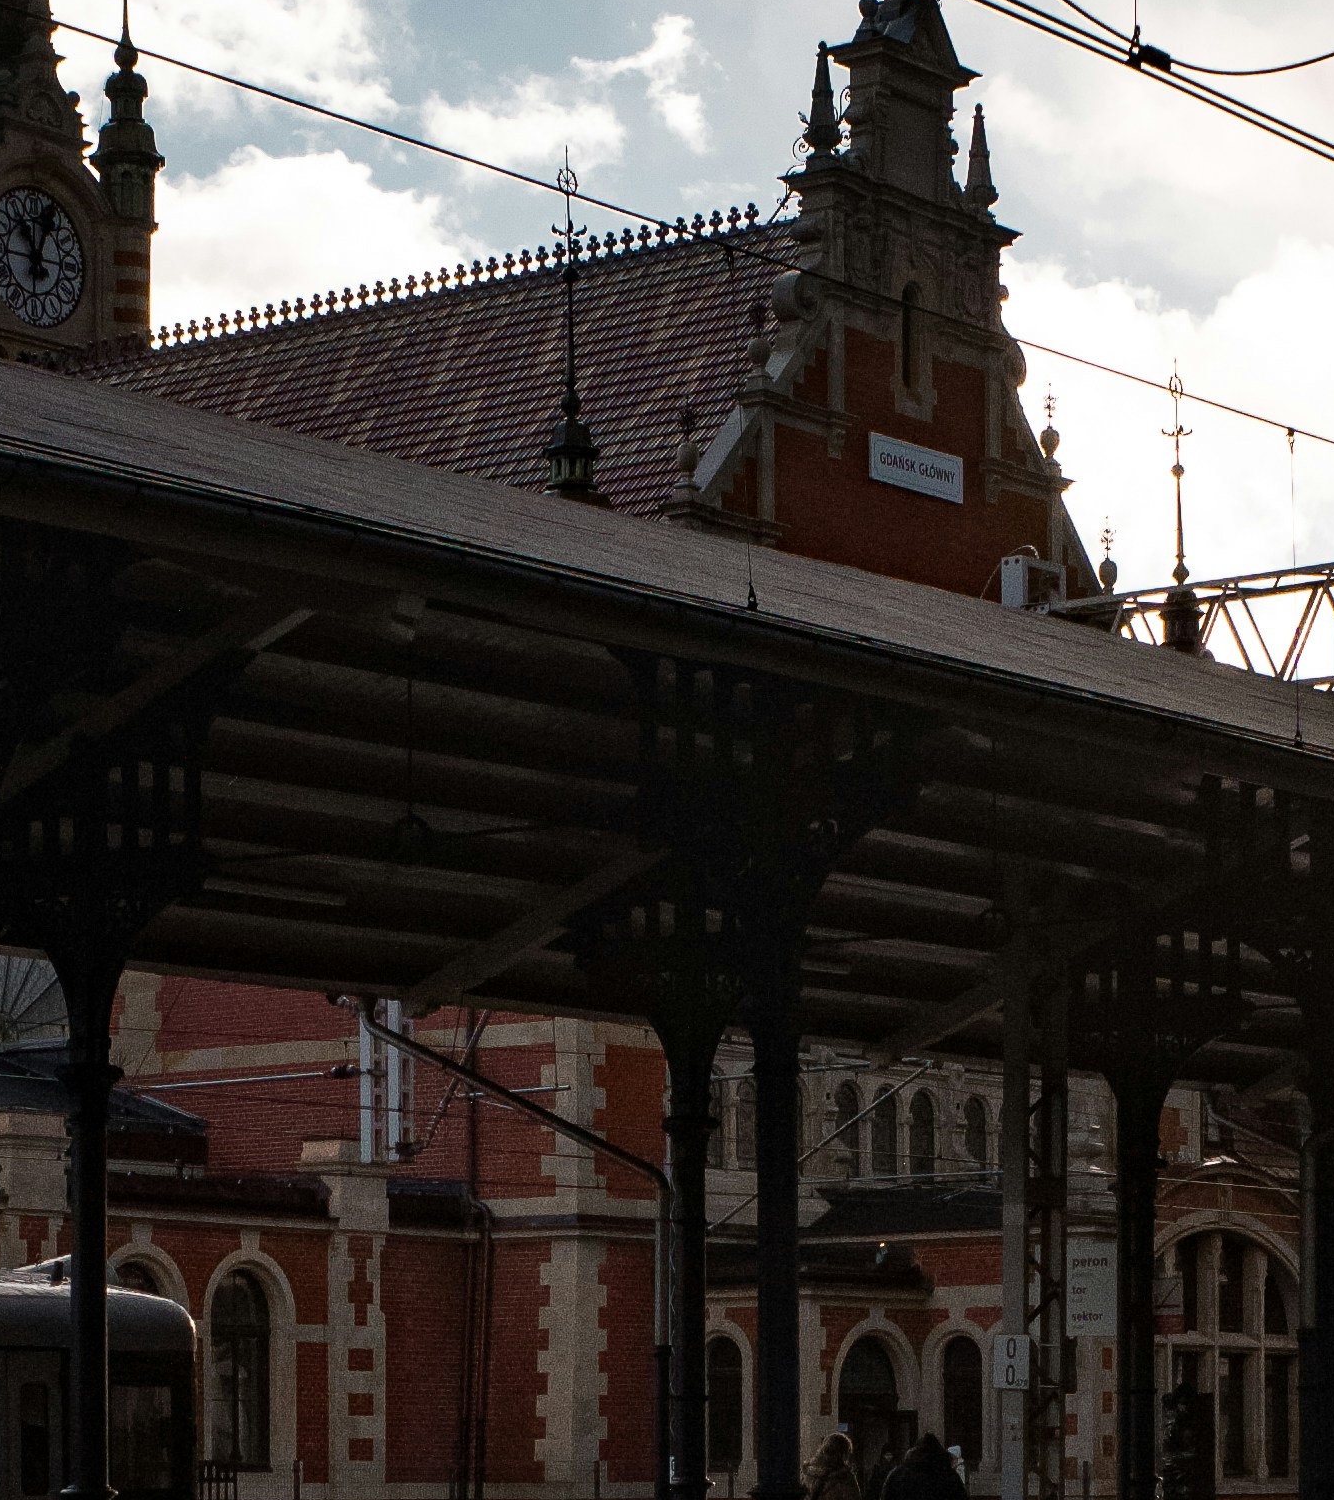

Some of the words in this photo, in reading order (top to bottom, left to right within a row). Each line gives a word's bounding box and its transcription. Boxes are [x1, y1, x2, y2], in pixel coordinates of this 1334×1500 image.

[879, 451, 917, 474] GDAŃSK
[918, 462, 956, 485] GŁÓWNY
[1072, 1256, 1108, 1270] peron
[1071, 1286, 1087, 1295] tor
[1071, 1311, 1104, 1322] sektor
[1006, 1337, 1017, 1359] 0
[1005, 1364, 1016, 1386] 0
